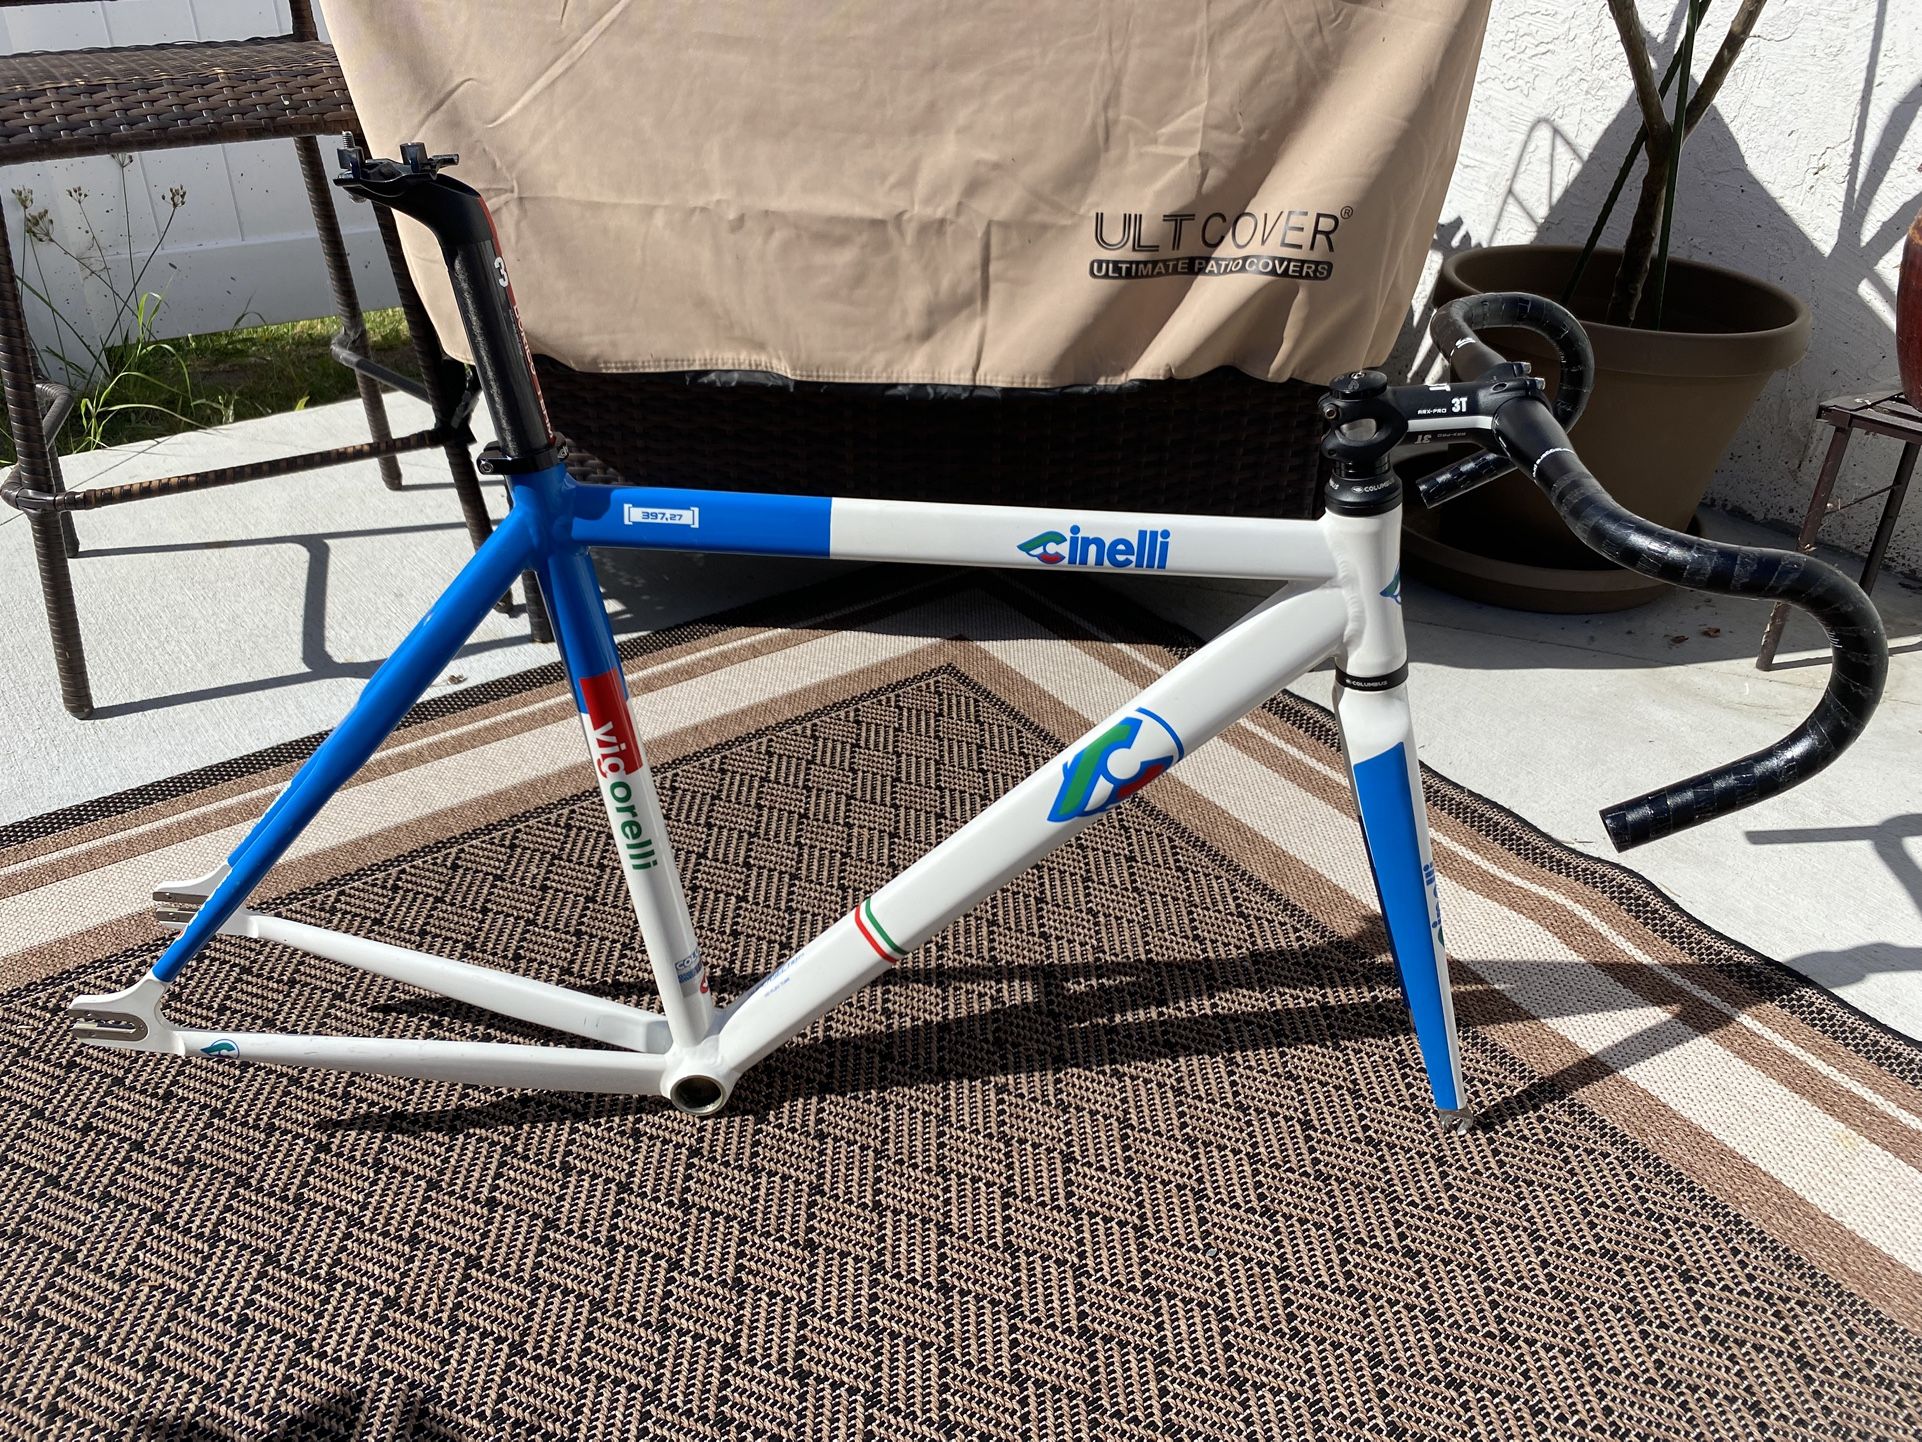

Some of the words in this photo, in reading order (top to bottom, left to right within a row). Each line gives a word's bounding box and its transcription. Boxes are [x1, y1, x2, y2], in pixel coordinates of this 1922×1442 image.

[1093, 259, 1189, 277] ULTIMATE
[1195, 258, 1242, 273] PATIO
[1245, 258, 1328, 278] COVERS
[1451, 397, 1468, 413] 3T
[593, 720, 658, 871] vigorelli
